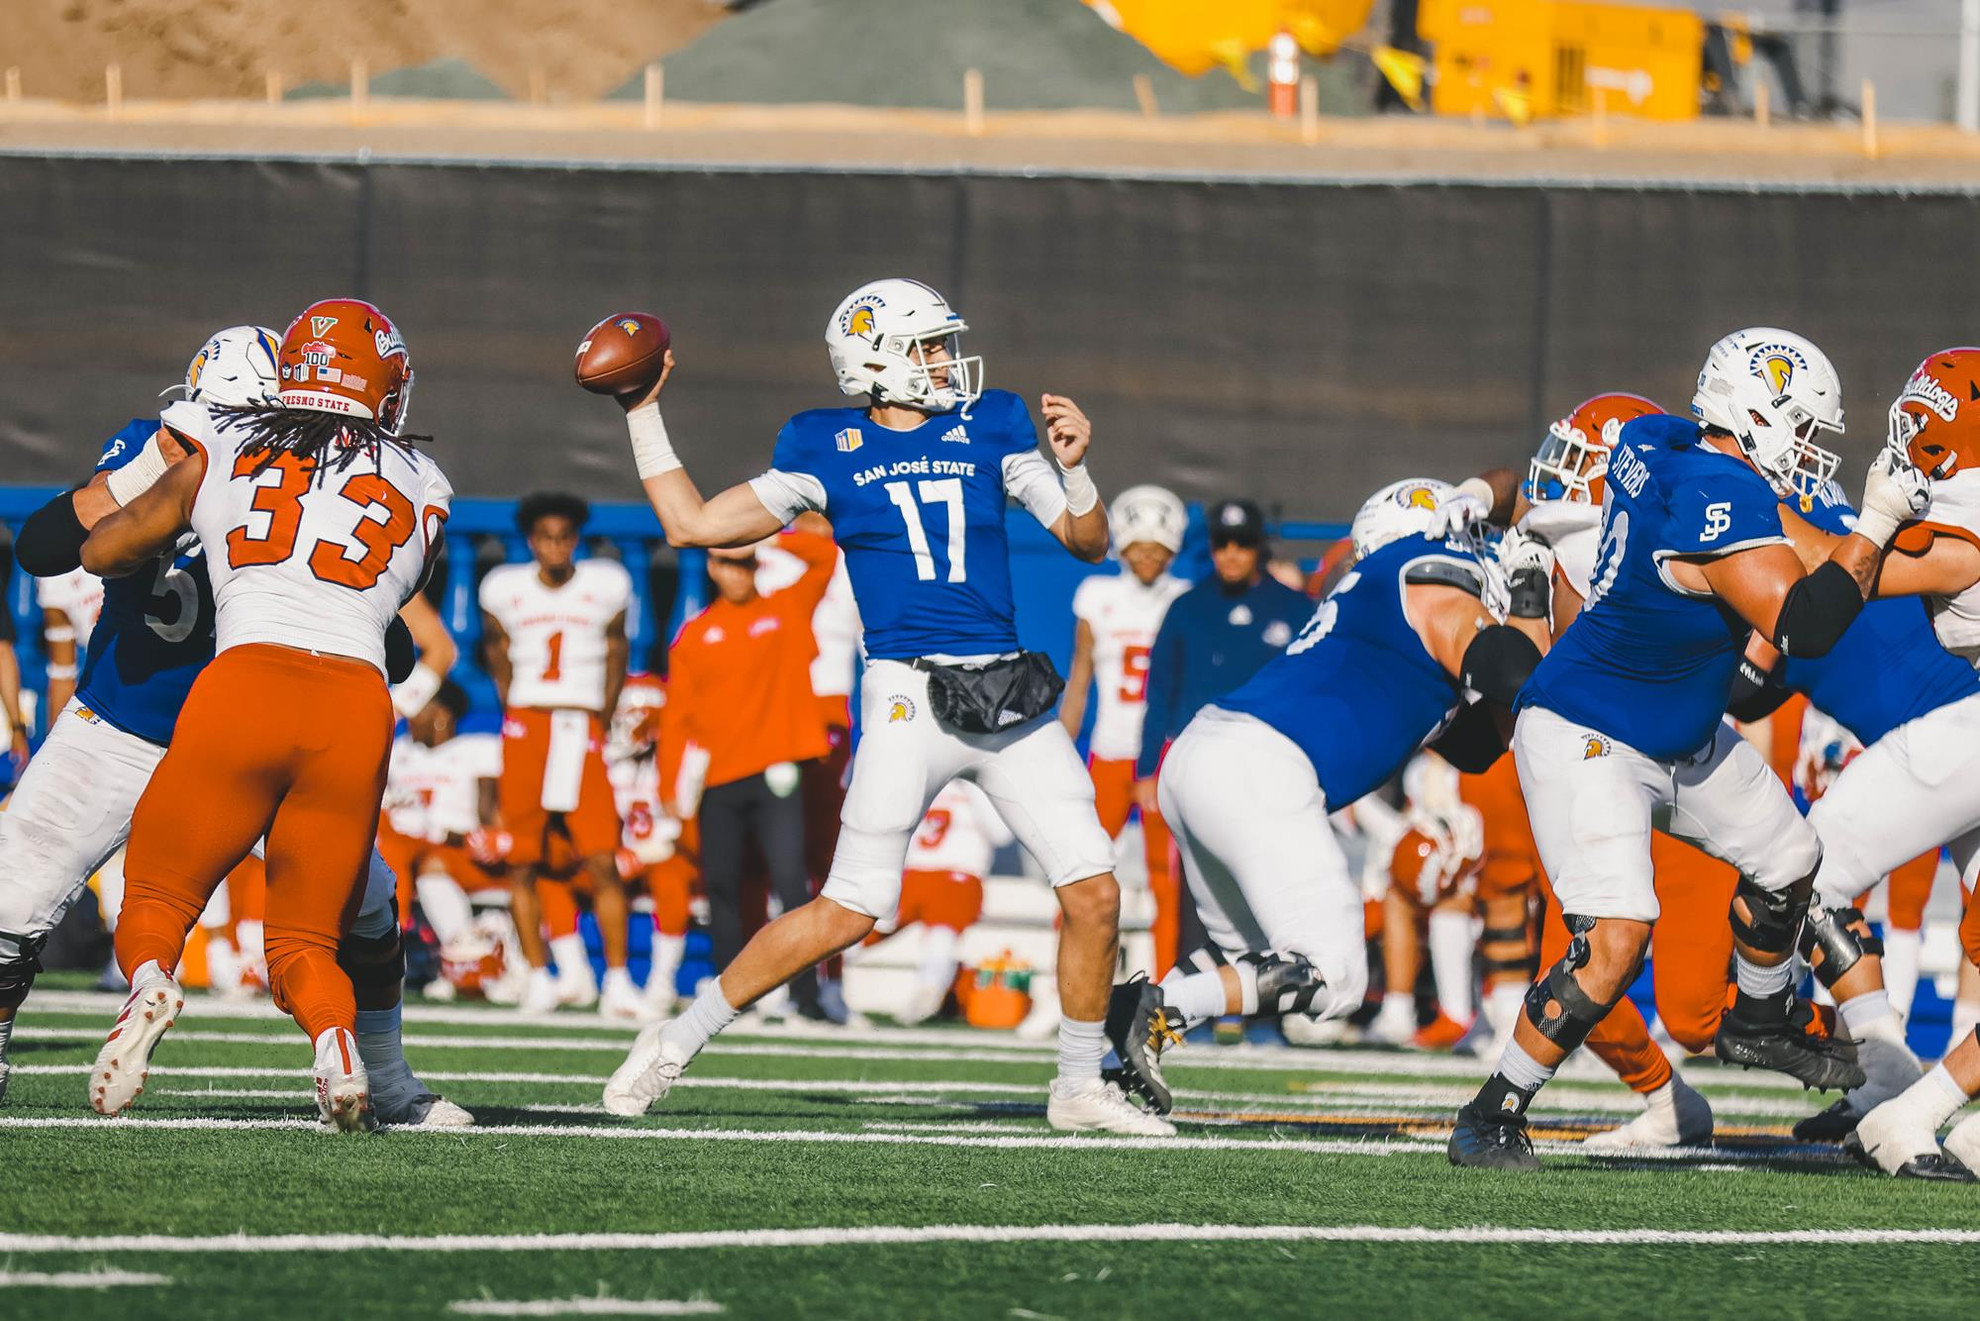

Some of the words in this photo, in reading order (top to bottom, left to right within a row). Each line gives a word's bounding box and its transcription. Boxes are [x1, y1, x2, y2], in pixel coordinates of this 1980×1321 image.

[310, 316, 338, 338] V
[305, 351, 329, 366] 100
[282, 396, 315, 406] FRESNO
[317, 398, 350, 412] STATE
[853, 464, 887, 487] SAN
[889, 455, 930, 476] JOSÉ
[932, 460, 976, 477] STATE
[1612, 442, 1650, 498] STEVENS
[226, 443, 417, 592] 33
[883, 477, 967, 584] 17
[539, 630, 564, 682] 1
[1119, 645, 1151, 703] 5
